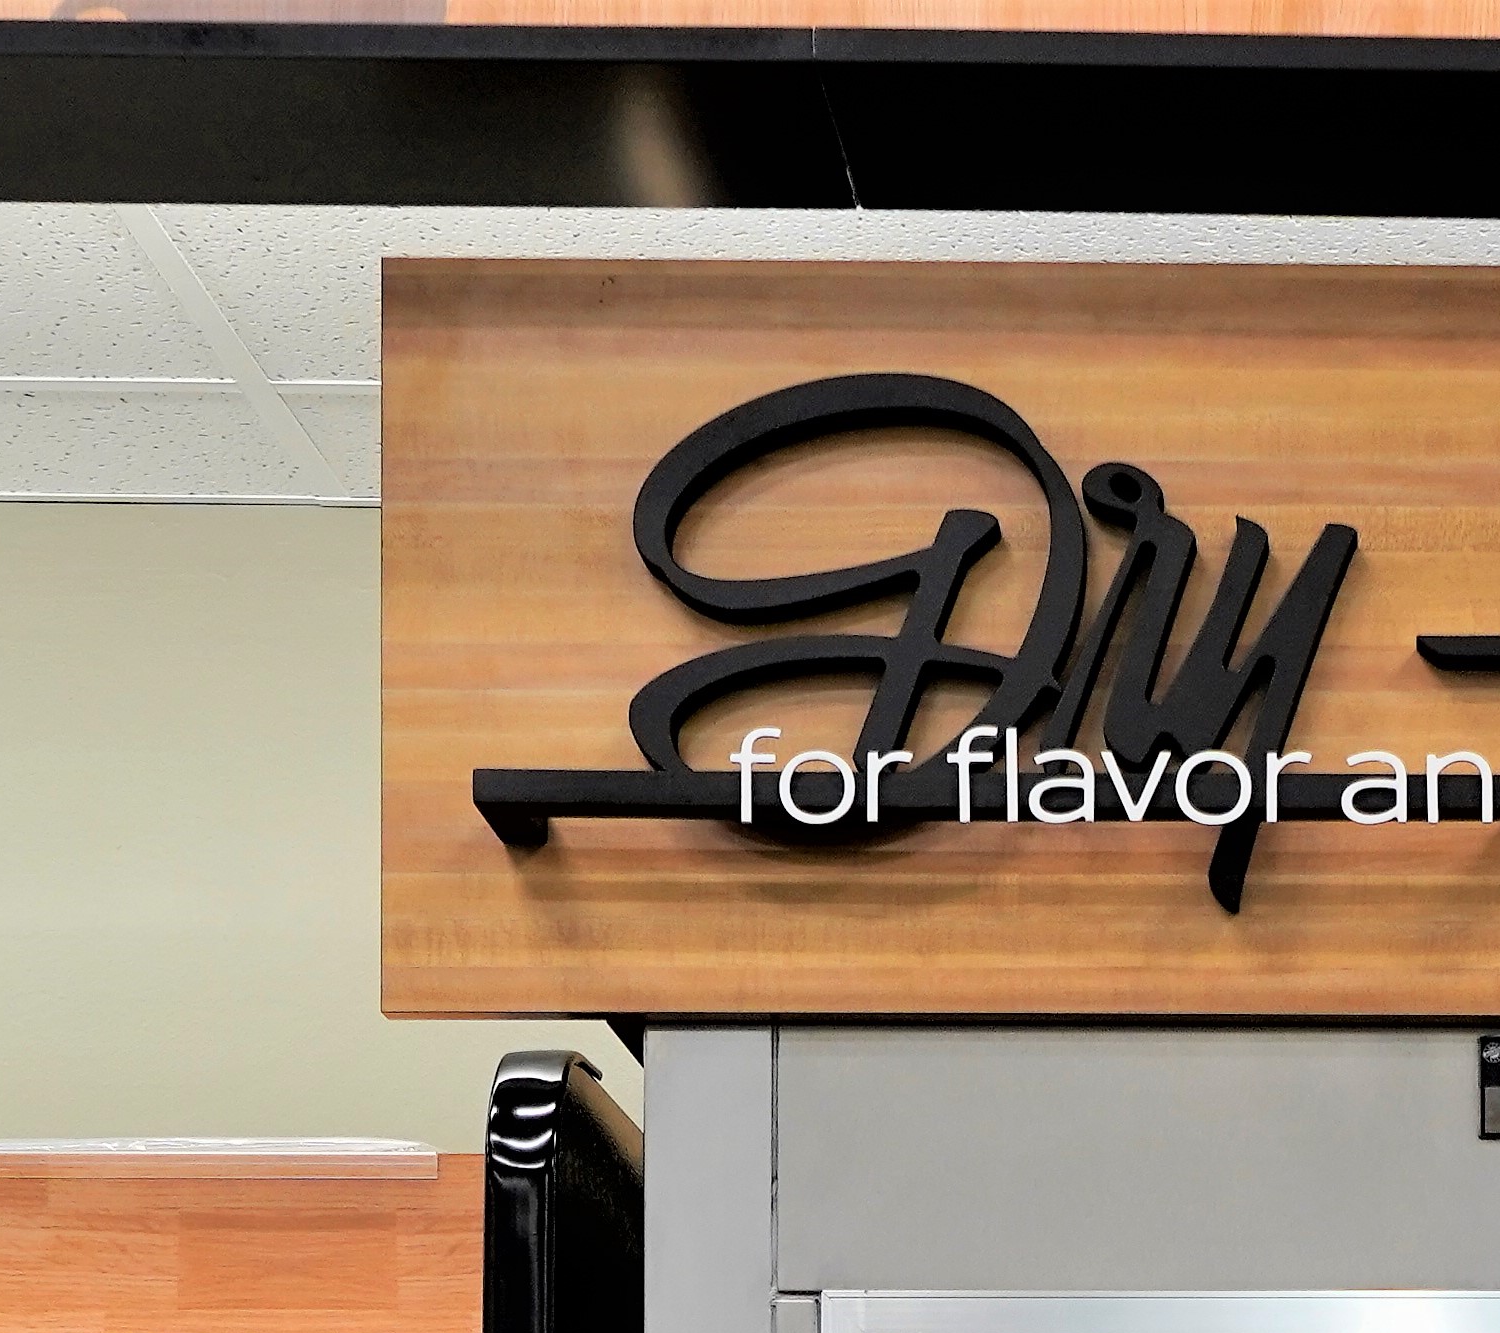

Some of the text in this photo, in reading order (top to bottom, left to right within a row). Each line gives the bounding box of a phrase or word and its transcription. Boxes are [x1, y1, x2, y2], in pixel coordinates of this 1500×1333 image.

[631, 370, 1360, 915] Dry
[730, 724, 914, 825] for
[946, 724, 1312, 825] flavor
